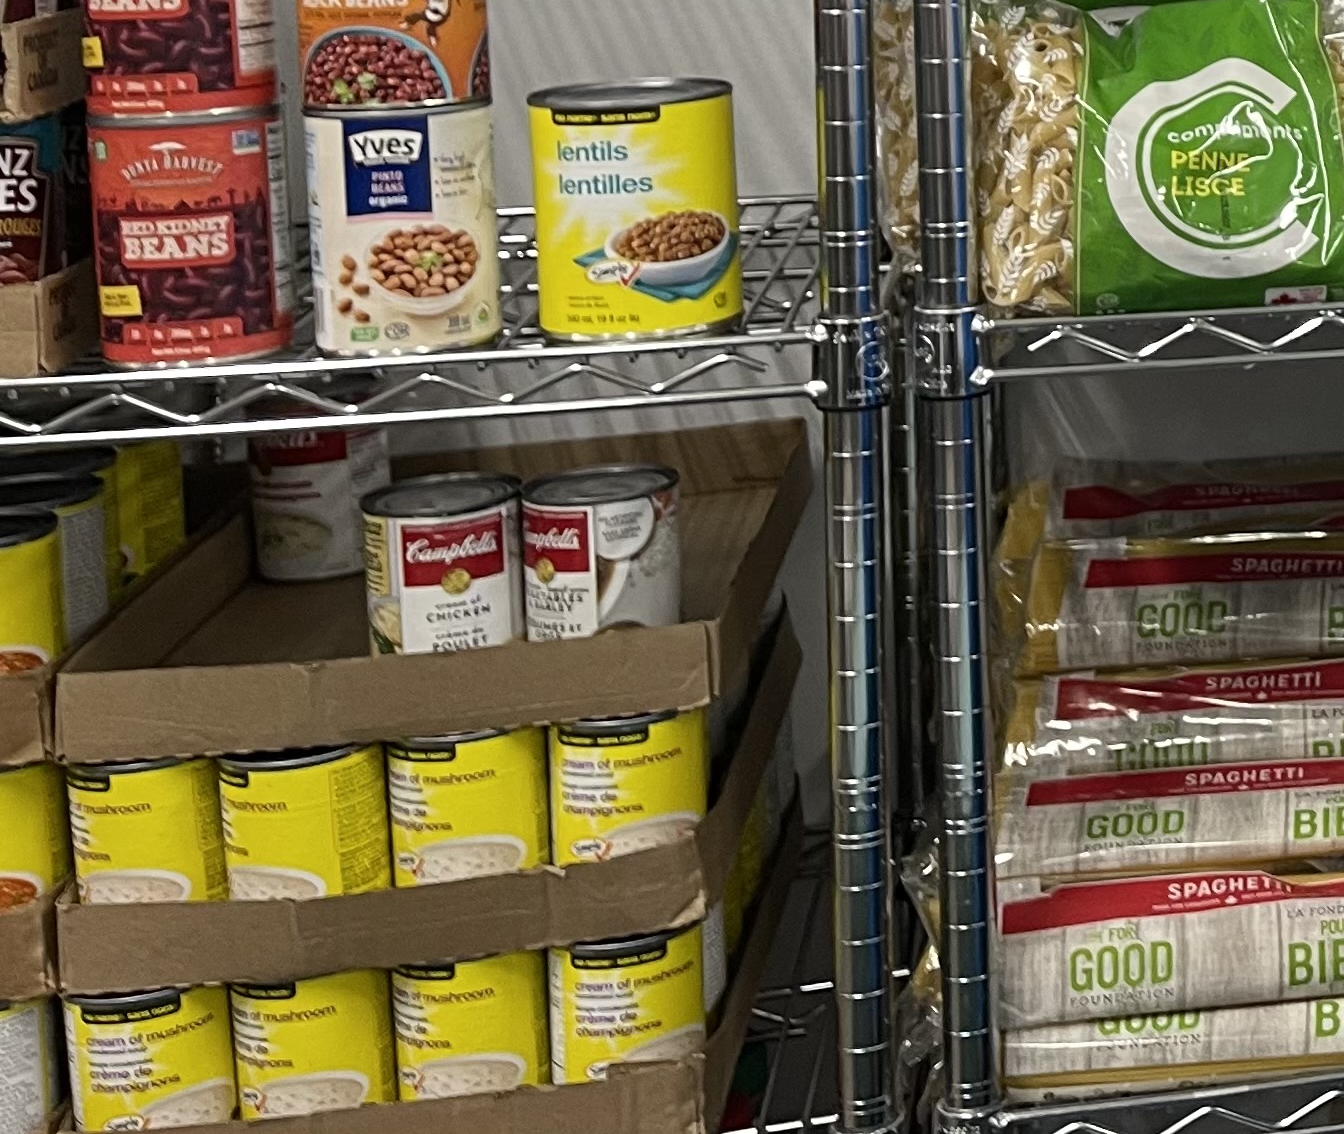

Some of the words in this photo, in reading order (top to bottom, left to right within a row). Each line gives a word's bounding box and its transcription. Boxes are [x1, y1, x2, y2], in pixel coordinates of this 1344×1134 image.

[353, 136, 416, 157] Yves
[557, 140, 628, 162] lentils
[1170, 150, 1251, 171] PENNE
[559, 173, 653, 195] lentilles
[1170, 175, 1246, 197] LISCE
[121, 219, 154, 236] RED
[155, 217, 230, 235] KIDNEY
[124, 233, 229, 262] BEANS
[1231, 557, 1344, 575] SPAGHETTI
[426, 604, 491, 624] CHICKEN
[1136, 600, 1228, 639] GOOD
[1205, 671, 1322, 691] SPAGHETTI
[1185, 767, 1304, 788] SPAGHETTI
[1086, 809, 1185, 840] GOOD
[1168, 875, 1293, 901] SPAGHETTI
[1070, 940, 1174, 992] GOOD
[262, 1004, 337, 1024] mushroom
